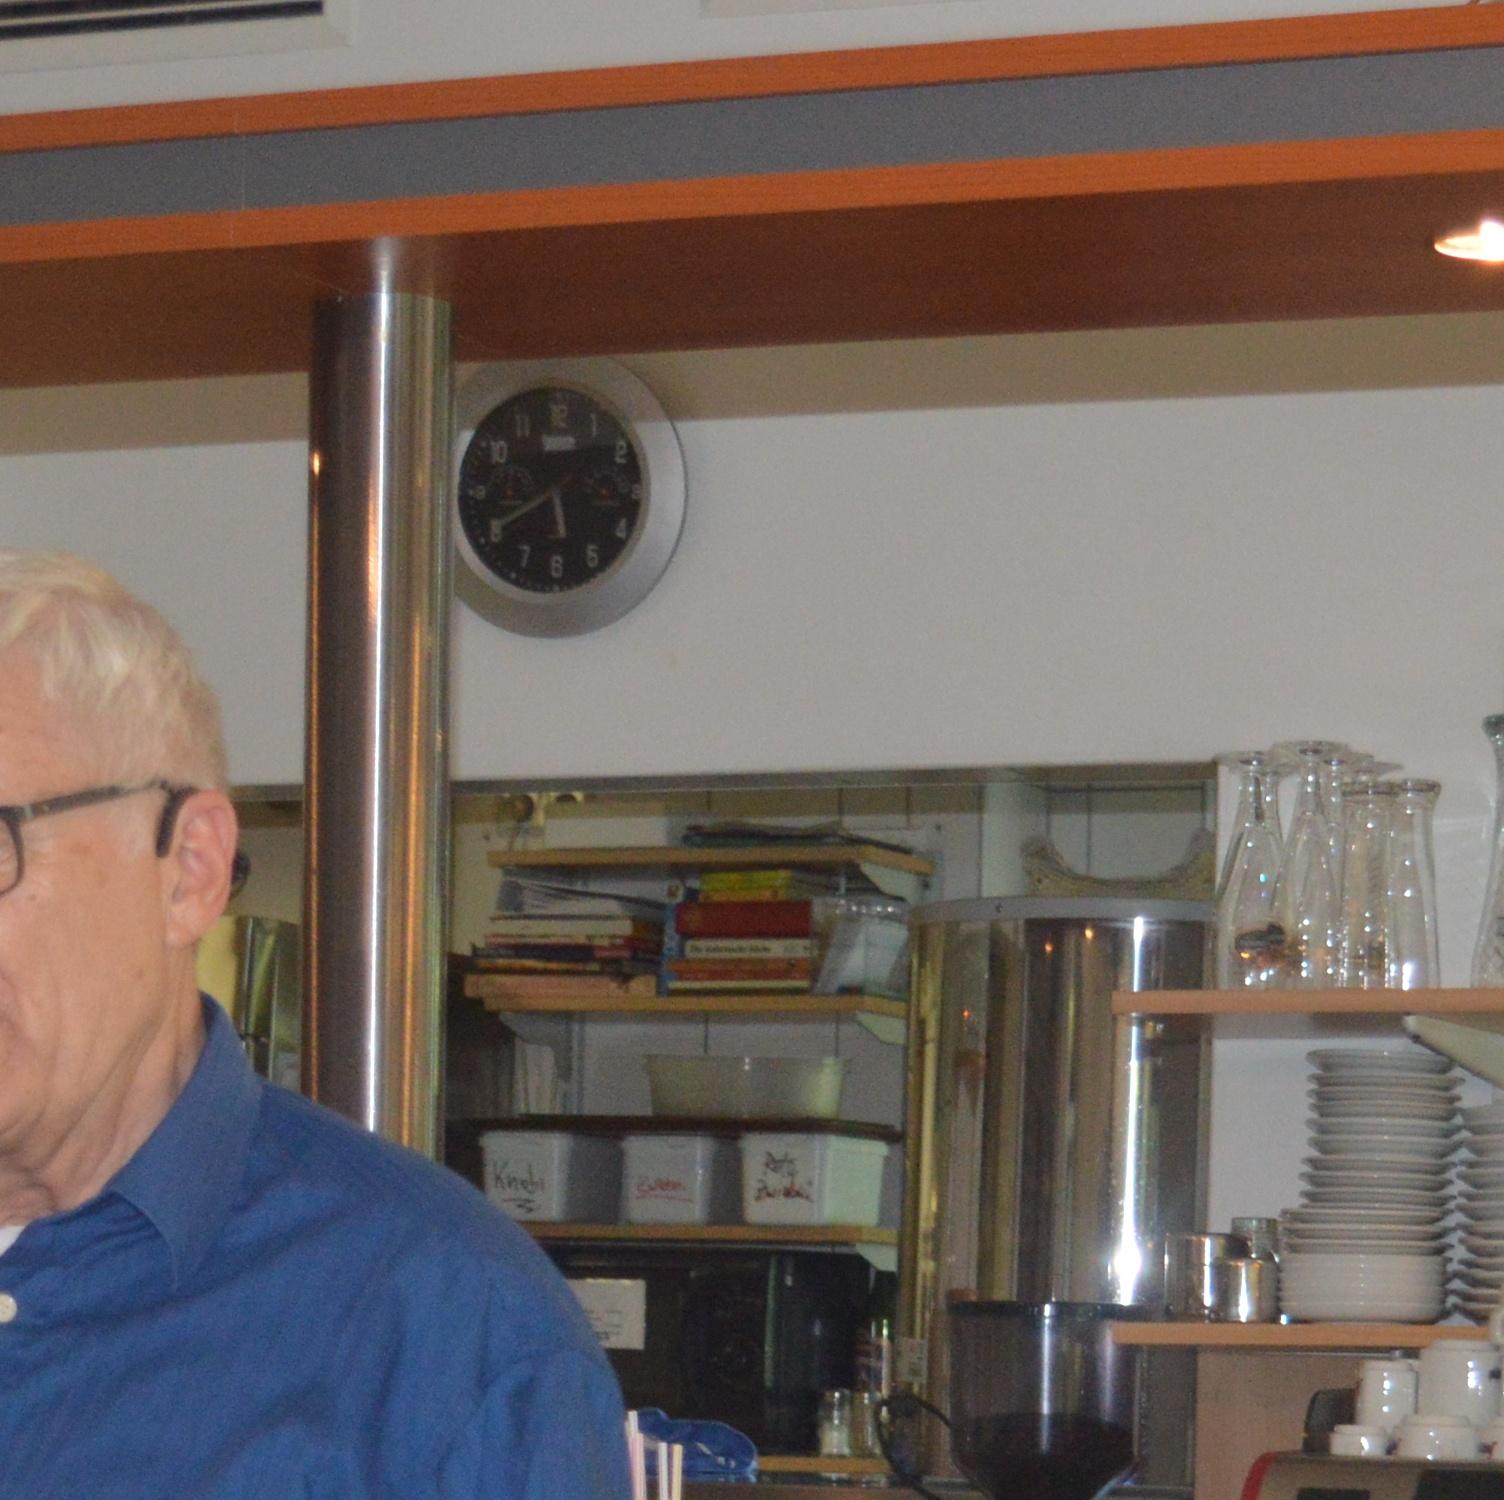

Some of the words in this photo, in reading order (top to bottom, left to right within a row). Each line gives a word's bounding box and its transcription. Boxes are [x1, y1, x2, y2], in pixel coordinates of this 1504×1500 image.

[490, 440, 509, 464] 10
[614, 439, 628, 464] 2
[614, 517, 627, 540] 4
[519, 545, 531, 568] 7
[550, 554, 564, 579] 6
[586, 544, 599, 568] 5
